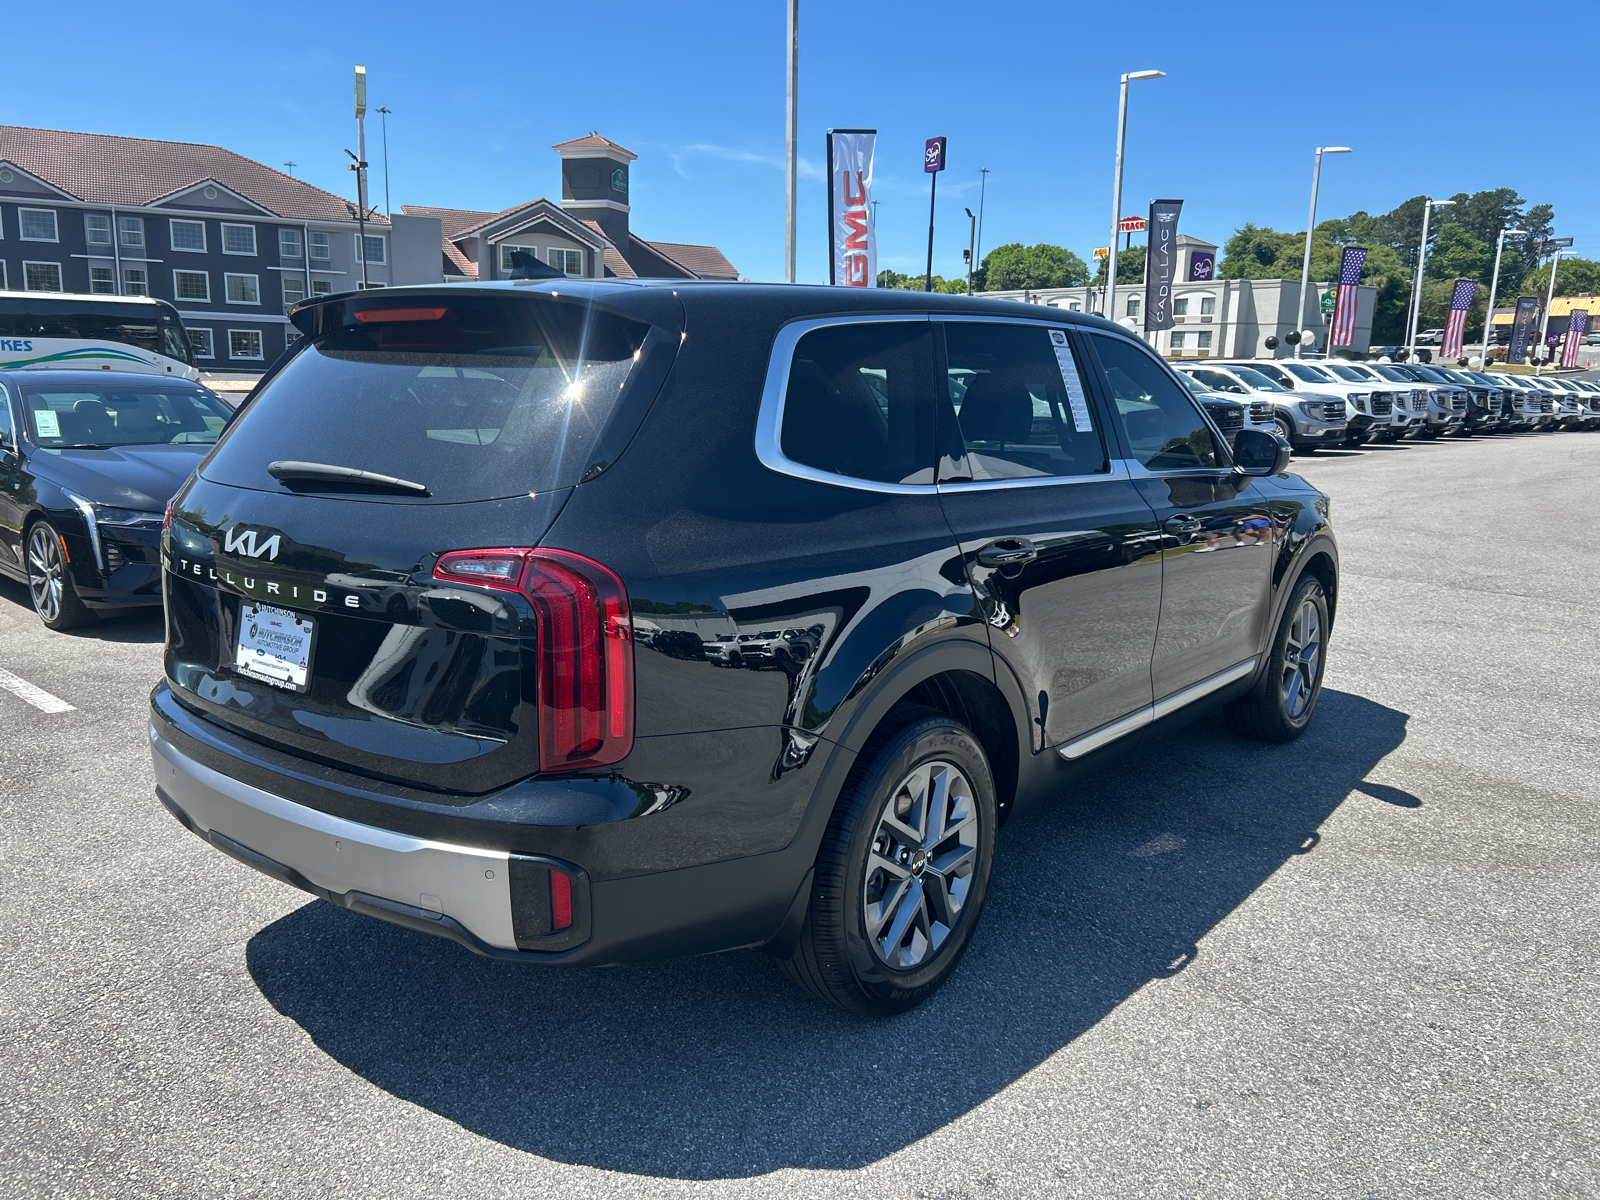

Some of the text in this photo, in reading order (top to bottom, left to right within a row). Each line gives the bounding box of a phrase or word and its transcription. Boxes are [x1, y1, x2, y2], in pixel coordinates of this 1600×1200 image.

[843, 170, 868, 287] GMC
[1118, 221, 1145, 231] TBACK
[1157, 229, 1169, 322] CADILLAC
[1, 340, 32, 351] KES
[1515, 311, 1529, 361] CADILLAC
[224, 527, 281, 561] KIA
[180, 559, 360, 608] TELLURIDE
[261, 603, 297, 619] HUTCHINSON
[256, 639, 299, 654] AUTOMOTIVE GROUP
[257, 627, 304, 648] HUTCHINSON
